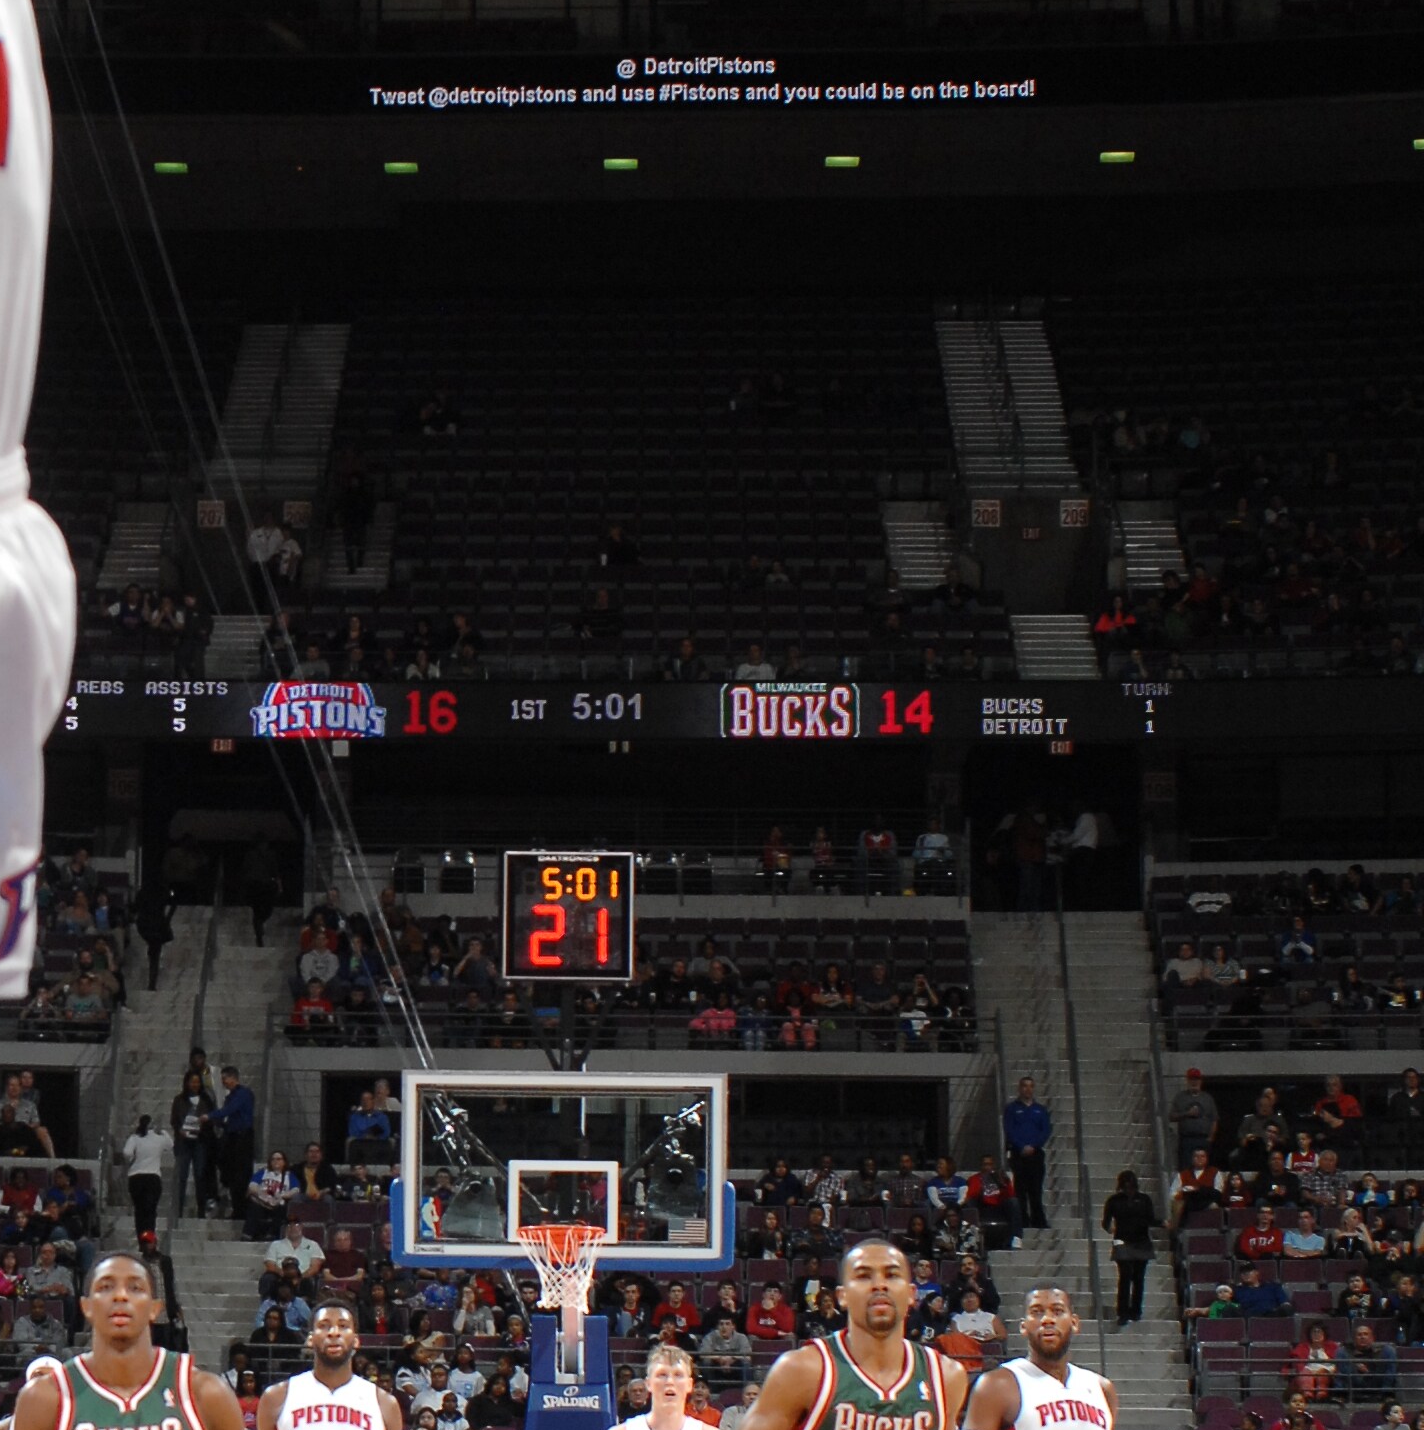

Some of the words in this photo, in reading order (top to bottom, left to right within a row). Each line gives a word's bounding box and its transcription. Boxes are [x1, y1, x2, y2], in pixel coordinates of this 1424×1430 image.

[645, 58, 776, 76] DetroitPistons
[369, 87, 425, 105] Tweet
[428, 85, 577, 108] @detroitpistons
[583, 85, 617, 102] and
[622, 88, 654, 102] use
[658, 84, 740, 102] #Pistons
[745, 83, 780, 100] and
[784, 87, 820, 104] you
[825, 82, 877, 100] could
[882, 82, 905, 99] be
[910, 85, 934, 99] on
[938, 81, 969, 98] the
[974, 80, 1036, 98] board!
[973, 508, 999, 526] 208
[1063, 509, 1087, 525] 209
[76, 680, 124, 694] REBS
[145, 681, 229, 695] ASSISTS
[289, 683, 355, 699] DETROIT
[755, 683, 827, 693] MILWAUKEE
[66, 696, 79, 710] 4
[173, 698, 186, 712] 5
[403, 690, 458, 734] 16
[511, 699, 546, 721] 1ST
[572, 693, 643, 721] 5:01
[730, 686, 852, 737] BUCKS
[879, 689, 934, 734] 14
[983, 698, 1044, 715] BUCKS
[1145, 700, 1155, 713] 1
[65, 716, 79, 730] 5
[173, 718, 186, 732] 5
[256, 702, 385, 736] PISTONS
[983, 718, 1068, 735] DETROIT
[1145, 720, 1155, 733] 1
[542, 867, 620, 901] 5:01
[529, 903, 609, 966] 21
[542, 1395, 600, 1410] SPALDING
[1036, 1399, 1107, 1430] PISTONS
